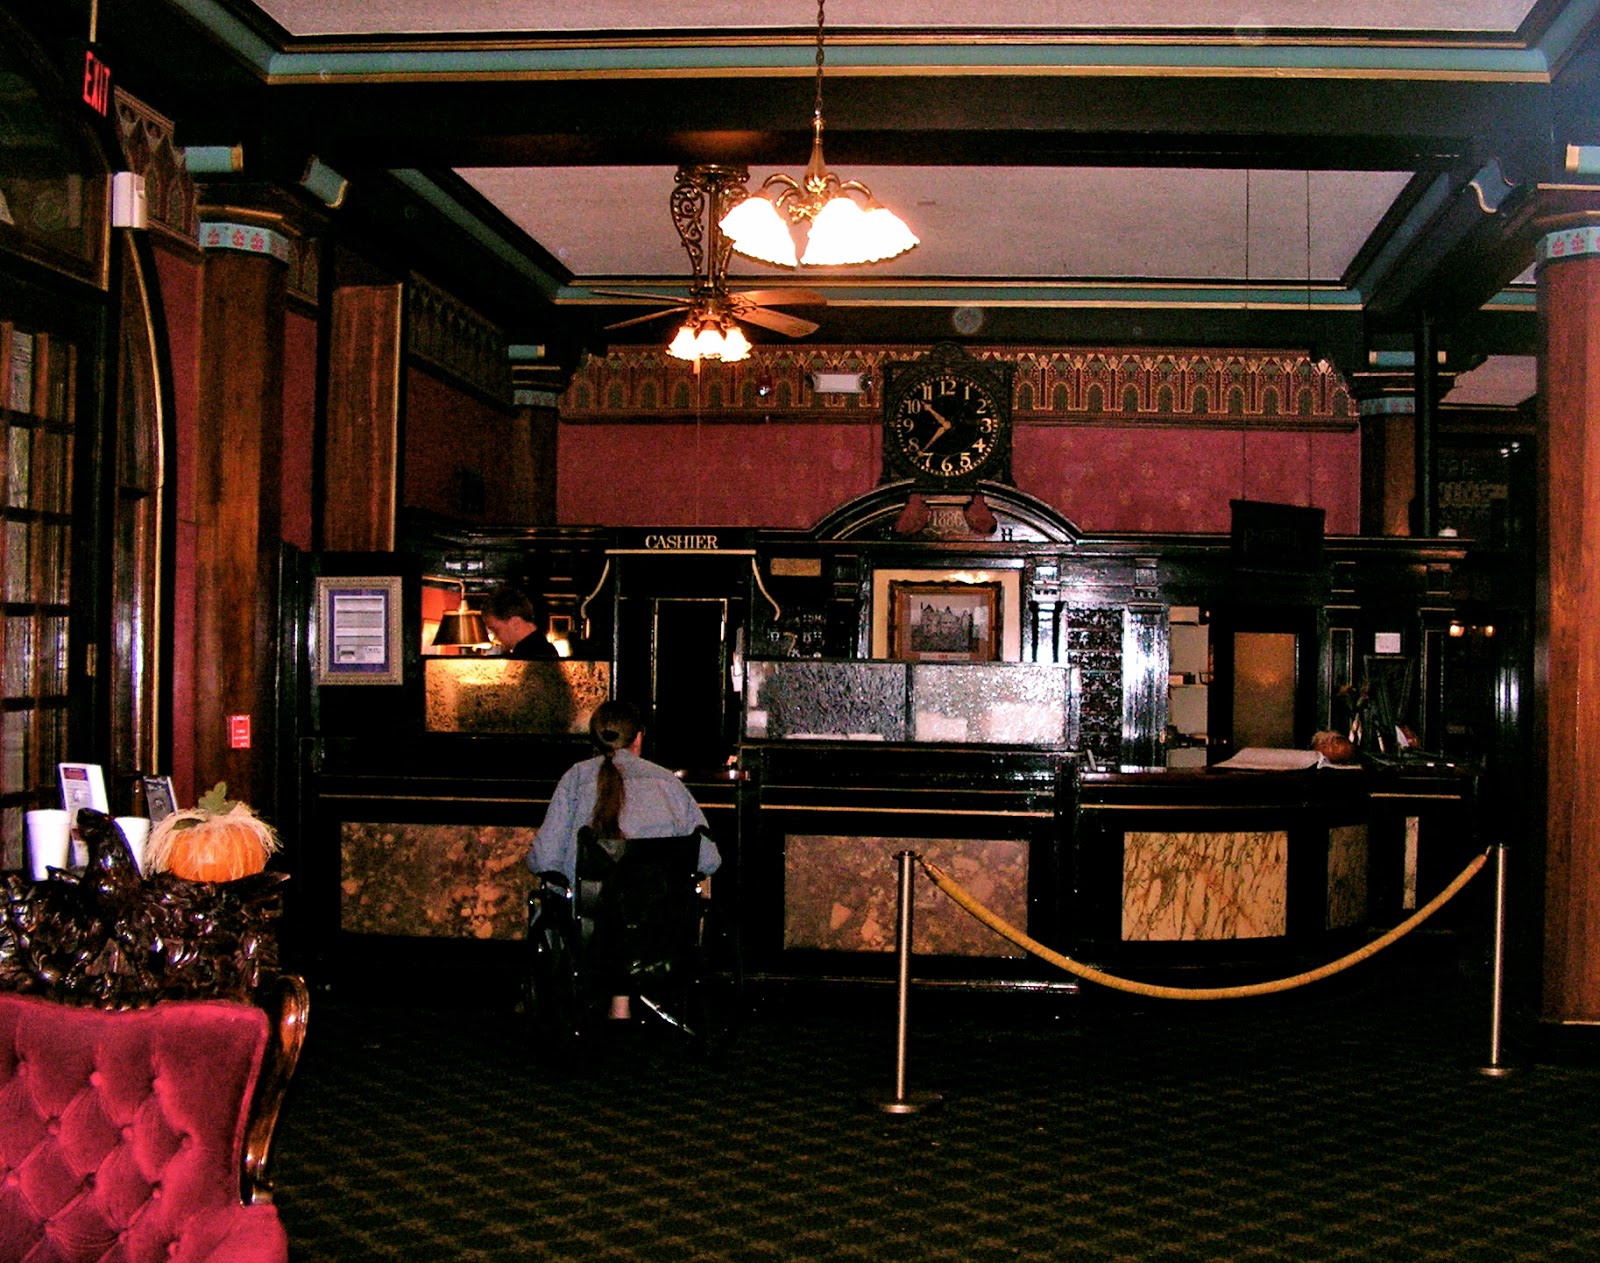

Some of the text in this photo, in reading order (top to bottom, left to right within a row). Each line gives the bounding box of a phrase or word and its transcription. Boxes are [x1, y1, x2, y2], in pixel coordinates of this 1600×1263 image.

[83, 50, 111, 117] EXIT
[922, 384, 933, 400] 11
[940, 380, 957, 395] 12
[964, 385, 970, 400] 1
[905, 399, 921, 414] 10
[976, 399, 987, 414] 2
[903, 418, 914, 433] 9
[979, 418, 992, 433] 3
[908, 437, 919, 452] 8
[971, 437, 986, 453] 4
[922, 452, 934, 468] 7
[941, 456, 953, 472] 6
[959, 452, 972, 468] 5
[645, 534, 718, 550] CASHIER
